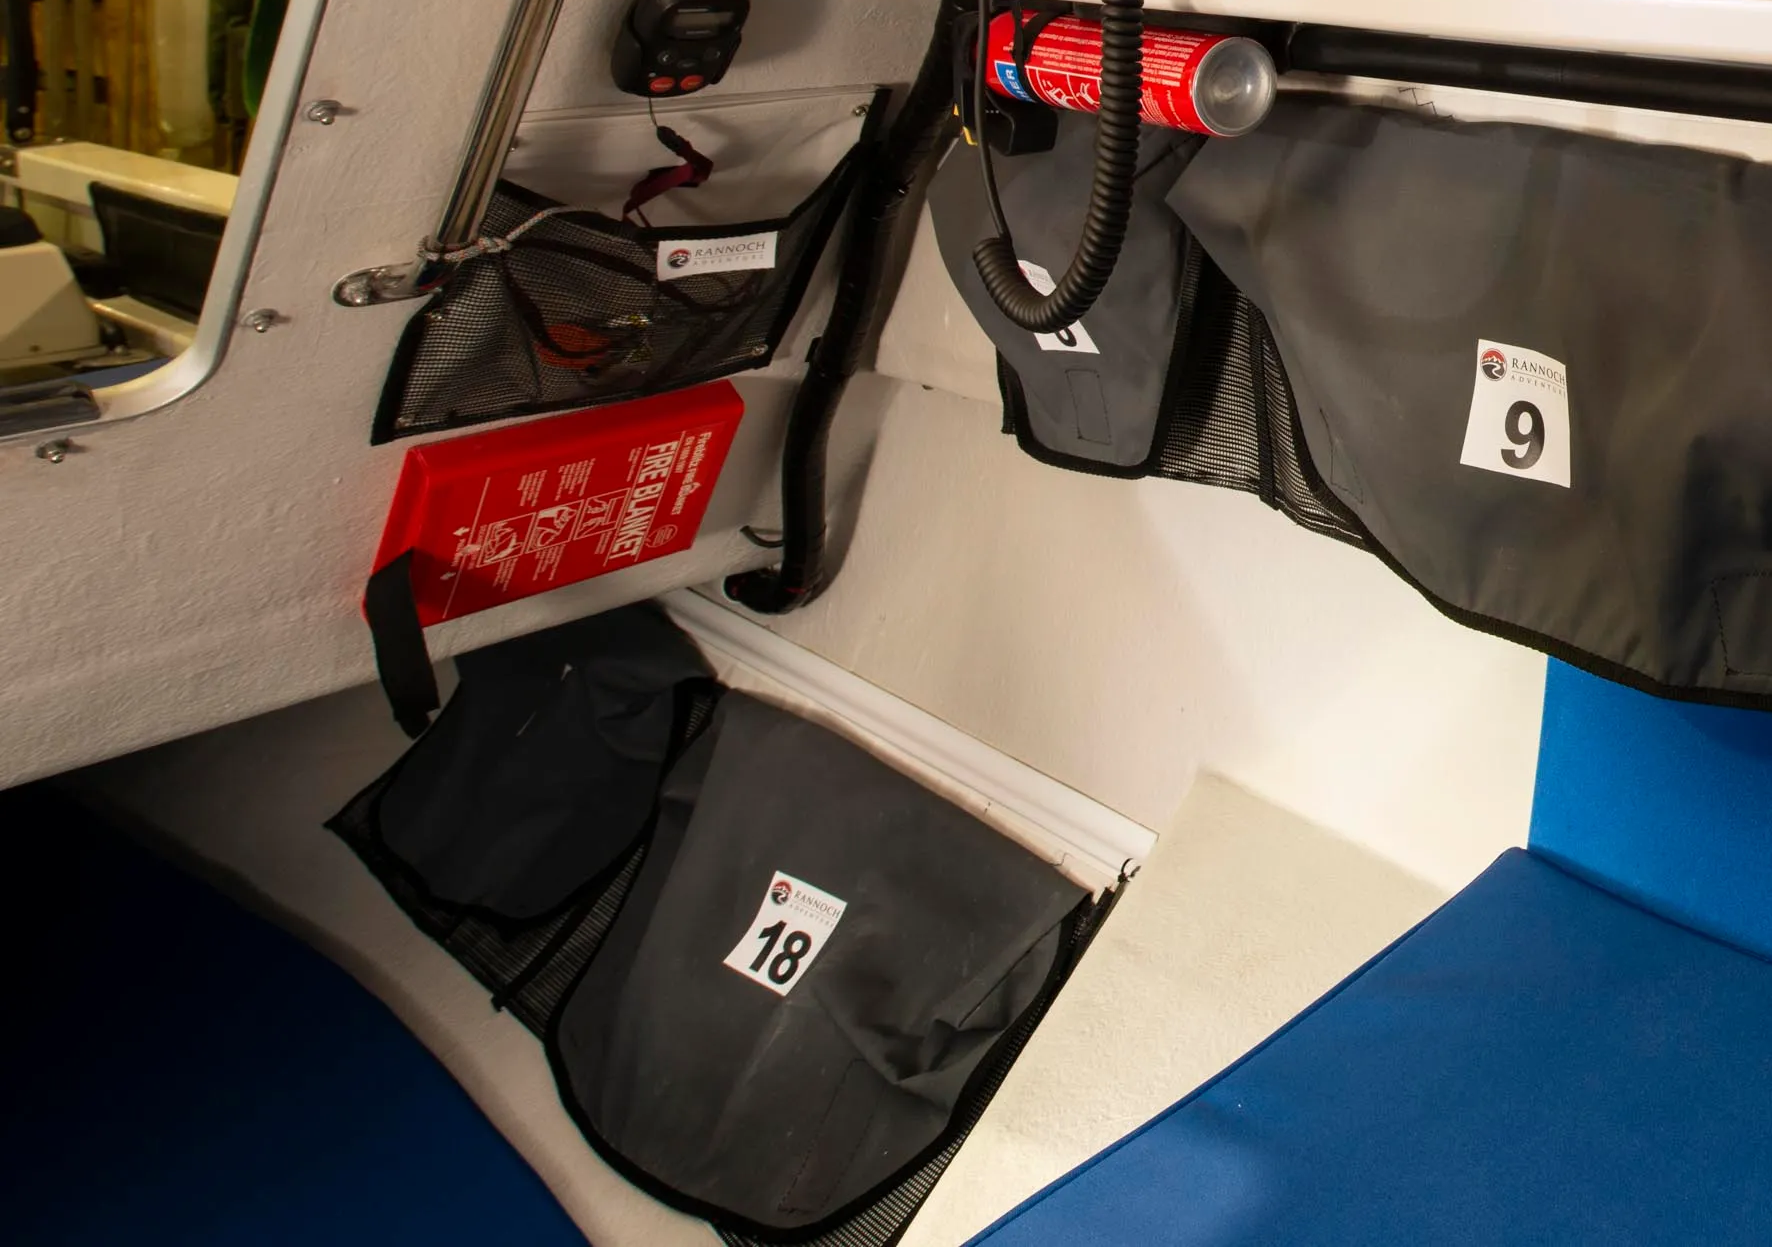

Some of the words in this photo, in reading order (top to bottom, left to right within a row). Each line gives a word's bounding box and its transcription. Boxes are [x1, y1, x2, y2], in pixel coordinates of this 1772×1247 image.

[695, 242, 766, 257] RANNOCH
[1511, 357, 1566, 385] RANNOCH
[1500, 400, 1546, 470] 9
[638, 440, 680, 484] FIRE
[608, 482, 664, 560] BLANKET
[793, 890, 842, 919] RANNOCH
[748, 920, 813, 985] 18
